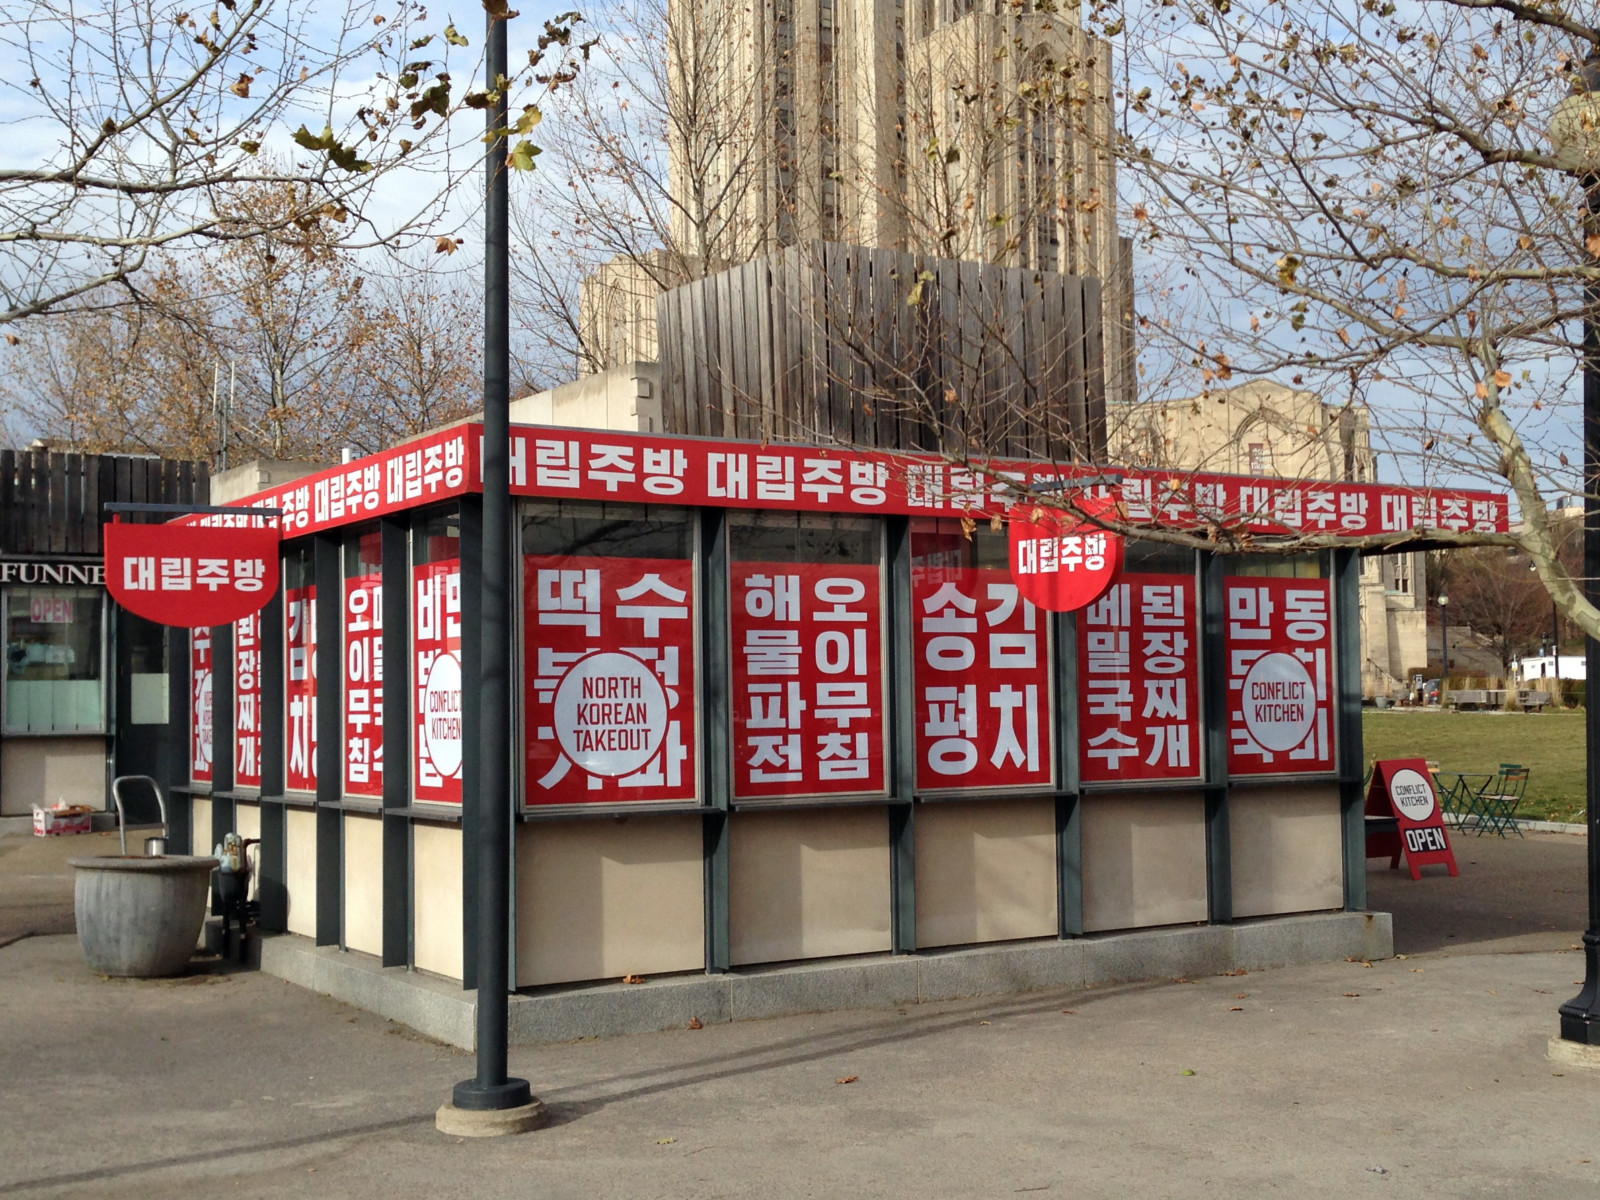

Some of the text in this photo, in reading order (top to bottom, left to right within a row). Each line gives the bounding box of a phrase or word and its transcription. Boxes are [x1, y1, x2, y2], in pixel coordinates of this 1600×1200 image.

[314, 463, 381, 522] 대립주방
[387, 436, 464, 504] 대립주방
[707, 452, 889, 506] 대립주방
[907, 464, 1066, 514] 대립주
[1083, 476, 1227, 522] 립주방
[1240, 486, 1368, 531] 대립주방
[1381, 494, 1498, 533] 대립주방
[1018, 533, 1106, 574] 대립주방
[123, 556, 265, 592] 대립주방
[31, 600, 72, 622] OPEN
[288, 598, 309, 779] 김치
[348, 588, 371, 783] 오이무침
[582, 677, 641, 698] NORTH
[743, 574, 806, 782] 해물파전
[812, 577, 871, 780] 오이무침
[985, 583, 1039, 772] 김치
[1087, 583, 1139, 770] 메밀국수
[1141, 585, 1190, 767] 된장찌개
[1251, 682, 1306, 700] CONFLICT
[432, 718, 461, 739] KITCHEN
[578, 703, 647, 725] KOREAN
[1255, 703, 1304, 722] KITCHEN
[573, 729, 651, 752] TAKEOUT
[1395, 784, 1426, 796] CONFLICT
[1400, 796, 1430, 807] KITCHEN
[1405, 827, 1447, 852] OPEN
